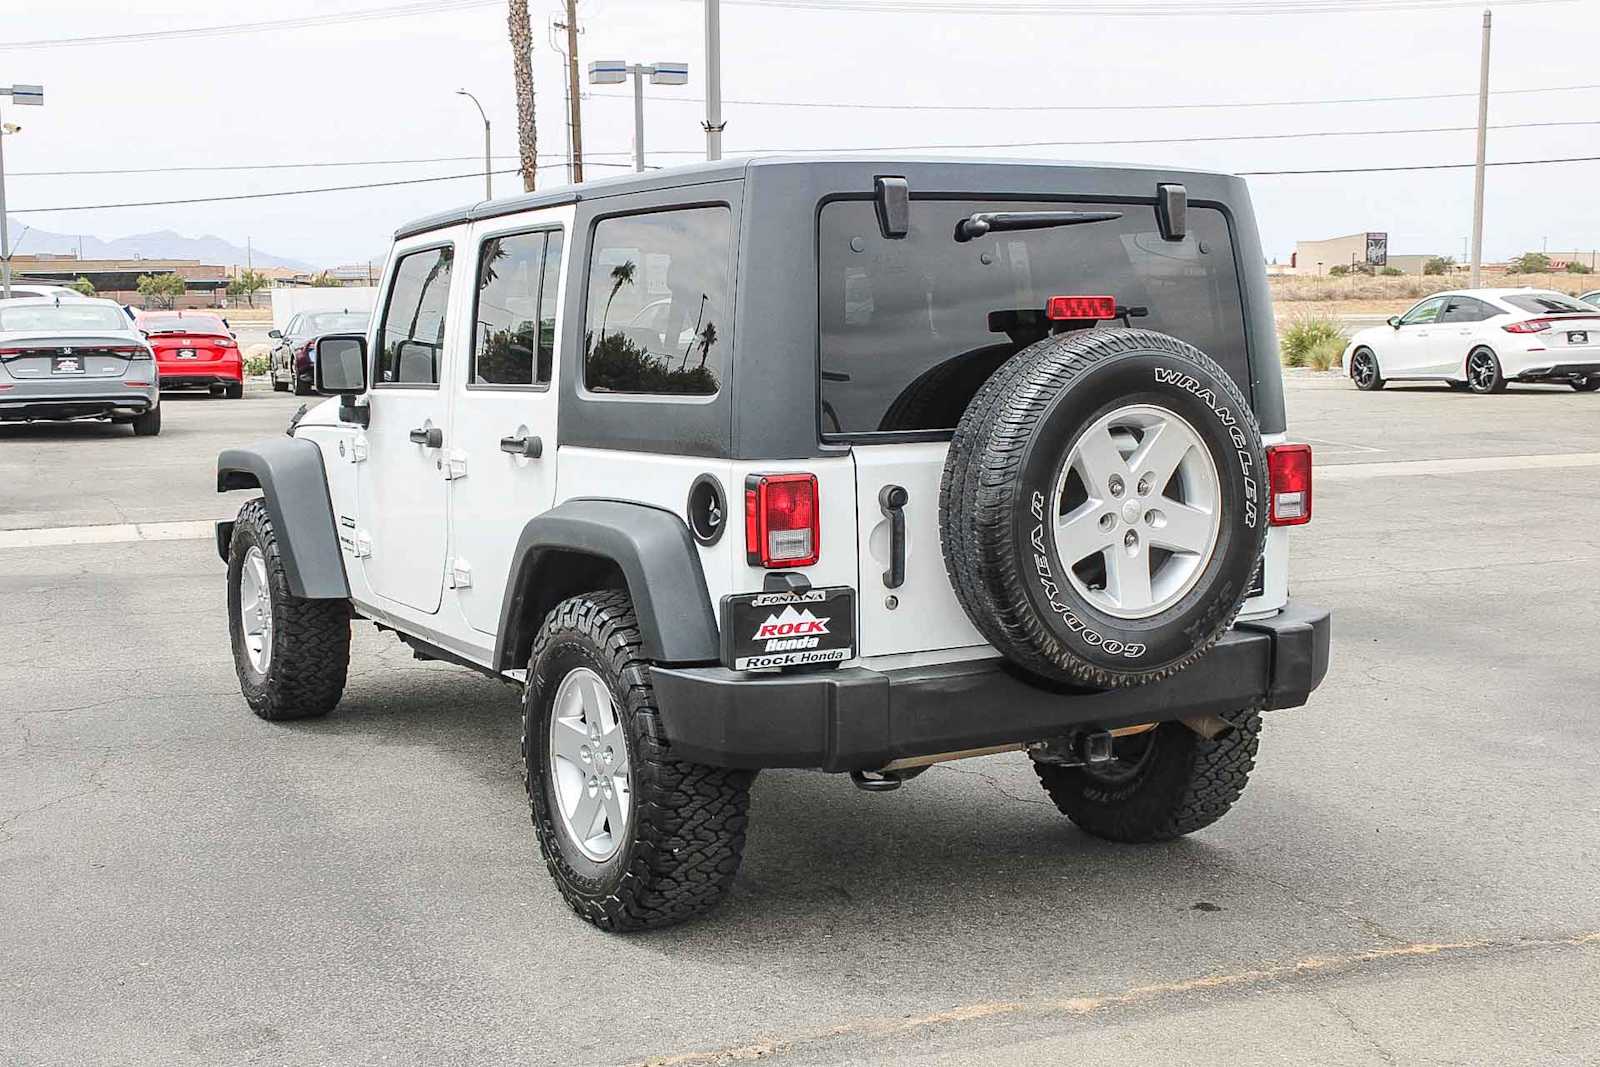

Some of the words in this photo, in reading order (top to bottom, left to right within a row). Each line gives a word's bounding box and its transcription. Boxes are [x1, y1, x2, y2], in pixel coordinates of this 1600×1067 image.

[1154, 367, 1258, 528] WRANGLER
[1031, 491, 1146, 658] GOODYEAR
[761, 593, 824, 604] FONTANA
[760, 621, 825, 637] ROCK
[765, 636, 820, 652] Honda
[746, 654, 797, 668] Rock
[800, 650, 844, 664] Honda
